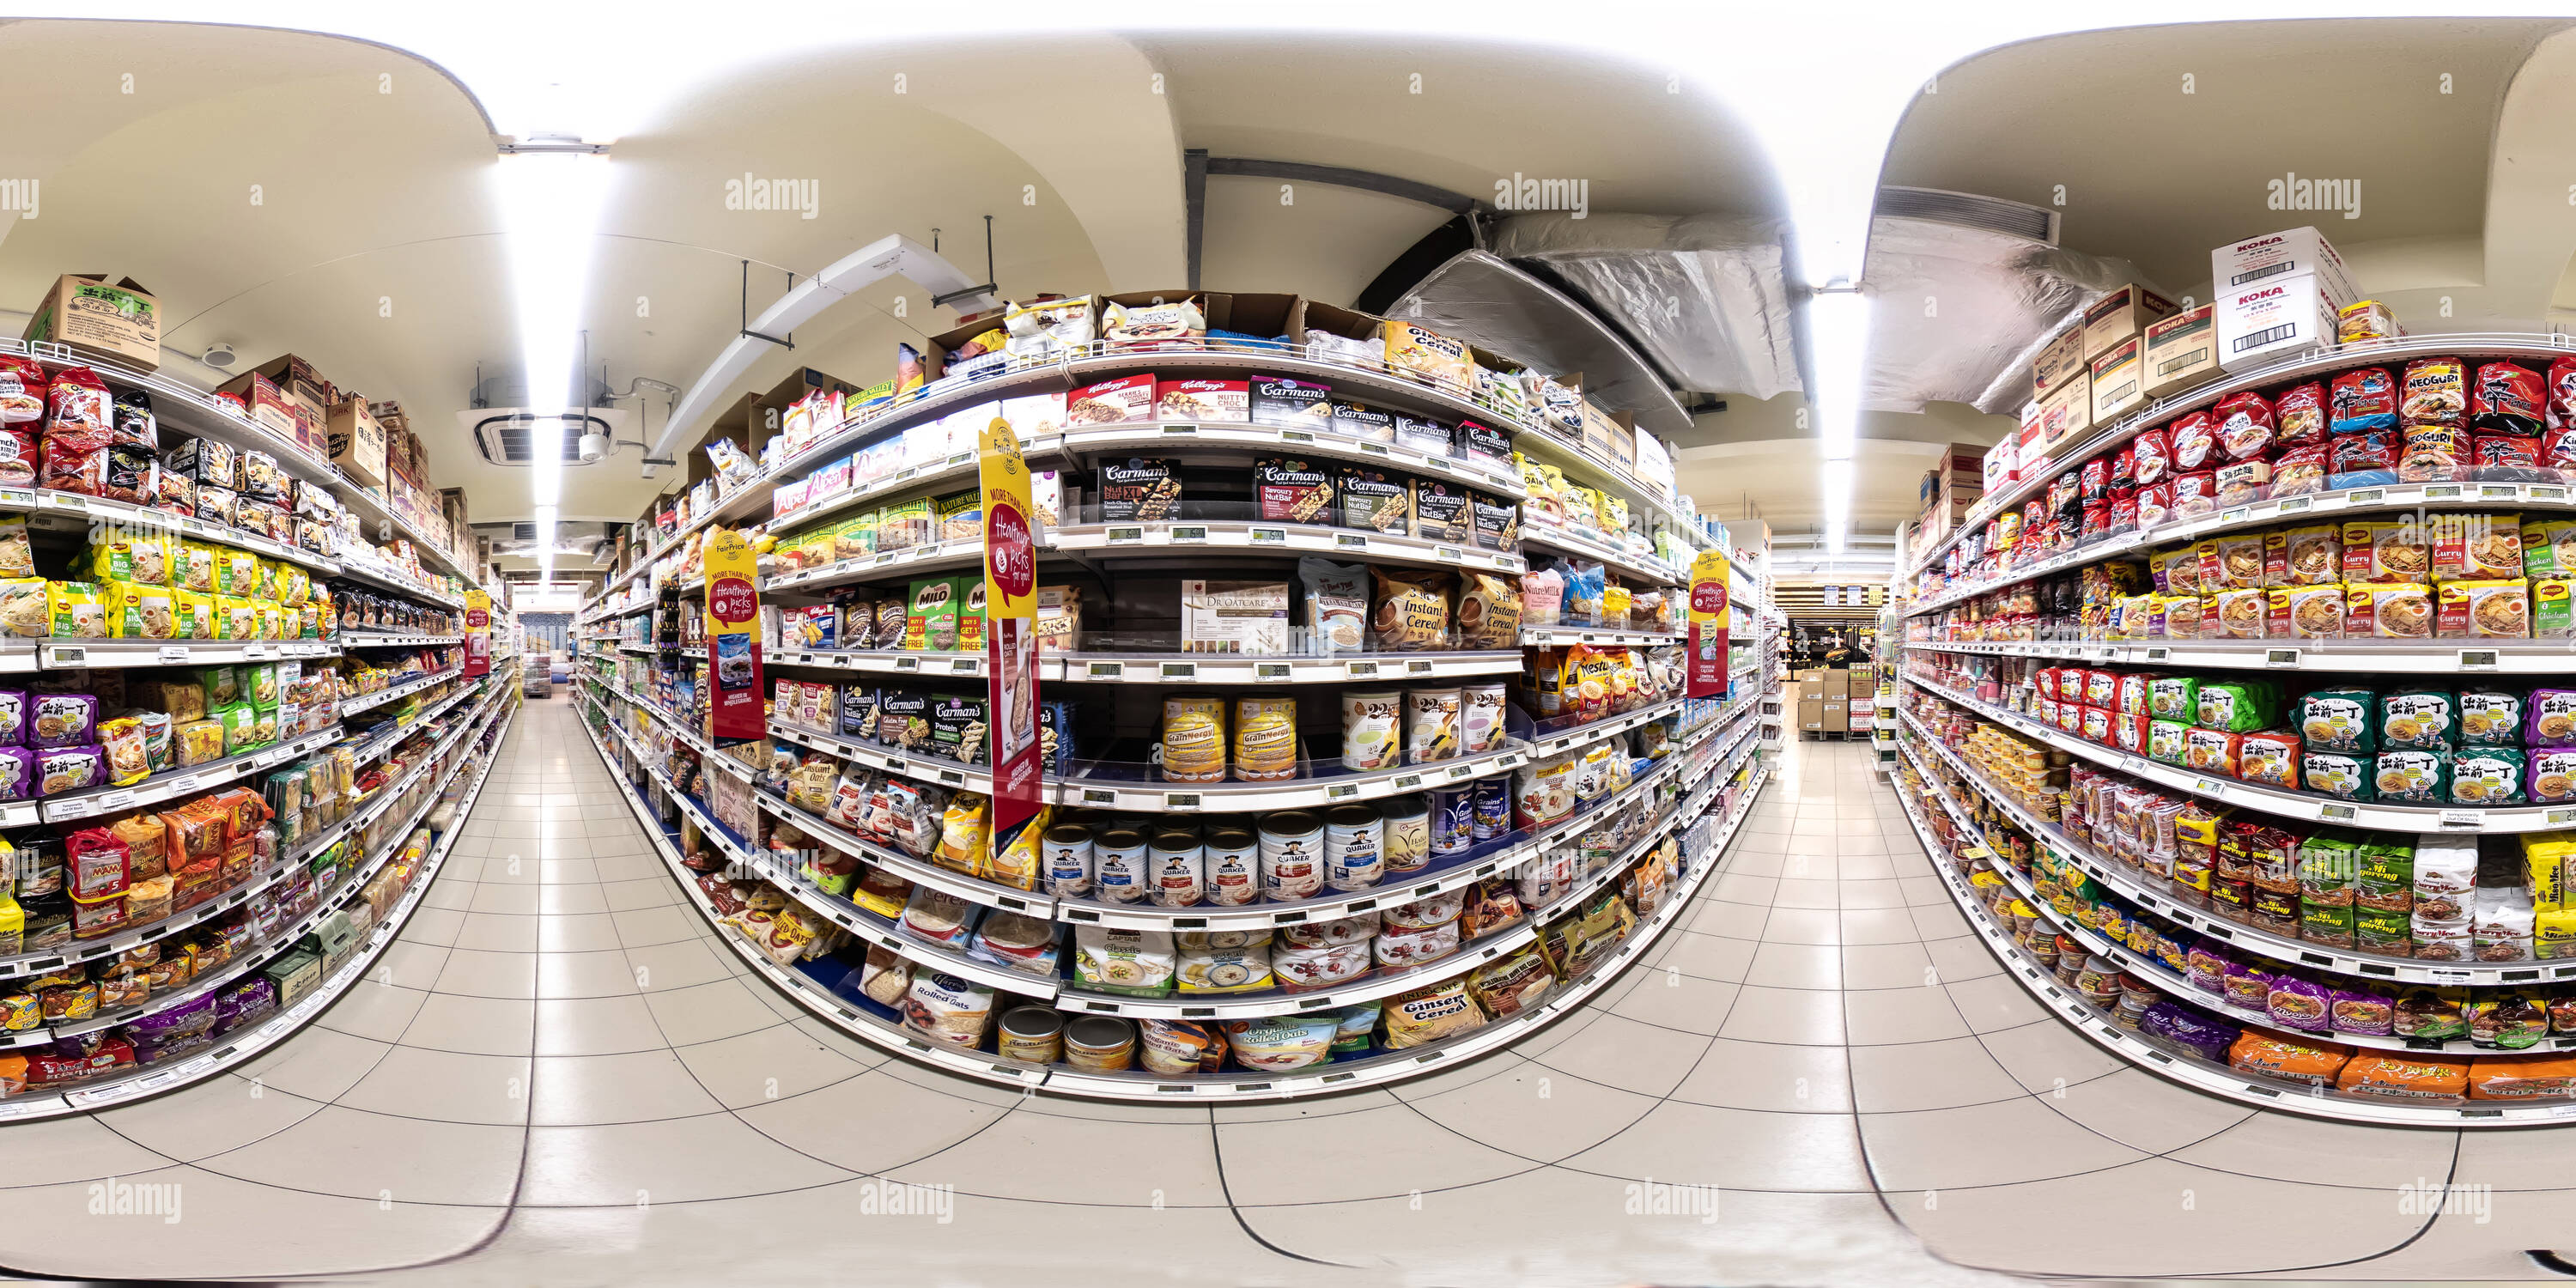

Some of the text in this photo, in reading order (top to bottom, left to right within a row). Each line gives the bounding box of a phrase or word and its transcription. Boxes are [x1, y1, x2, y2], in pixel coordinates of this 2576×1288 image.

[2237, 236, 2283, 252] KOKA
[2319, 237, 2342, 268] KOKA
[2239, 286, 2284, 306] KOKA
[2089, 301, 2109, 316] KOKA
[2158, 317, 2184, 333] KOKA
[1408, 327, 1464, 353] Ginseng
[1414, 336, 1461, 359] Cereal
[2099, 353, 2117, 368] KOKA
[1088, 380, 1130, 394] Kellogg's
[1181, 380, 1227, 389] Kellogg's
[2408, 374, 2458, 389] NEOGURI
[869, 382, 892, 398] VALLEY
[1261, 383, 1325, 398] Carman's
[1334, 404, 1389, 422] Carman's
[1401, 418, 1450, 438] Carman's
[1469, 428, 1510, 448] Carman's
[2407, 432, 2451, 447] NEOGURI
[993, 438, 1021, 461] FairPrice
[1106, 465, 1170, 480] Carman's
[1265, 466, 1325, 482] Carman's
[1347, 477, 1400, 493] Carman's
[989, 487, 1021, 510] MORE THAN
[1347, 495, 1372, 505] Savoury
[1419, 489, 1465, 505] Carman's
[901, 498, 927, 513] VALLEY
[940, 495, 962, 515] NATURE
[1475, 502, 1513, 517] Carman's
[995, 512, 1030, 547] Healthier
[716, 543, 744, 553] FairPrice
[2434, 549, 2462, 559] Curry
[1010, 545, 1030, 572] picks
[2344, 555, 2369, 564] Curry
[2524, 557, 2552, 567] Chicken
[176, 562, 187, 571] BIG
[712, 571, 728, 581] MORE
[744, 573, 753, 581] 100
[717, 584, 753, 598] Healthier
[919, 591, 947, 605] MILO
[1697, 586, 1724, 597] Healthier
[730, 596, 751, 611] picks
[1206, 597, 1266, 607] DR OATCARE
[1704, 595, 1722, 607] picks
[1404, 600, 1443, 617] Instant
[1488, 604, 1519, 618] Instant
[2538, 611, 2569, 620] Chicken
[126, 614, 139, 623] BIG
[1406, 616, 1440, 630] Cereal
[1486, 616, 1515, 629] Cereal
[2347, 617, 2371, 627] Curry
[2440, 614, 2466, 623] Curry
[55, 622, 70, 630] BIG
[907, 639, 924, 648] FREE
[960, 641, 981, 651] FREE
[2155, 683, 2184, 695] 出前一丁
[844, 693, 875, 704] Carman's
[884, 696, 925, 710] Carman's
[2201, 693, 2233, 706] 出前一丁
[2463, 697, 2515, 712] 出前一丁
[43, 703, 87, 716] 出前一丁
[936, 703, 981, 717] Carman's
[2308, 704, 2360, 720] 出前一丁
[2391, 700, 2445, 715] 出前一丁
[935, 722, 957, 732] Protein
[1168, 727, 1214, 742] GrainNergy
[1245, 727, 1290, 742] GrainNergy
[2245, 744, 2287, 758] 出前一丁
[46, 756, 94, 775] 出前一丁
[804, 765, 831, 774] Instant
[2308, 759, 2356, 775] 出前一丁
[2380, 756, 2434, 772] 出前一丁
[810, 772, 825, 782] Oats
[2458, 764, 2512, 780] 出前一丁
[1346, 843, 1376, 853] QUAKER
[2220, 843, 2247, 858] goreng
[2303, 865, 2339, 879] goreng
[2315, 861, 2328, 871] Mi
[2372, 864, 2386, 873] Mi
[2360, 869, 2398, 882] goreng
[112, 880, 119, 890] 5
[2256, 902, 2291, 915] goreng
[2305, 915, 2343, 926] goreng
[2359, 921, 2397, 934] goreng
[2372, 918, 2387, 927] Mi
[1105, 945, 1141, 954] Classic
[917, 986, 970, 1010] Rolled Oats
[1413, 998, 1468, 1021] Cereal
[1280, 1030, 1309, 1042] Oats
